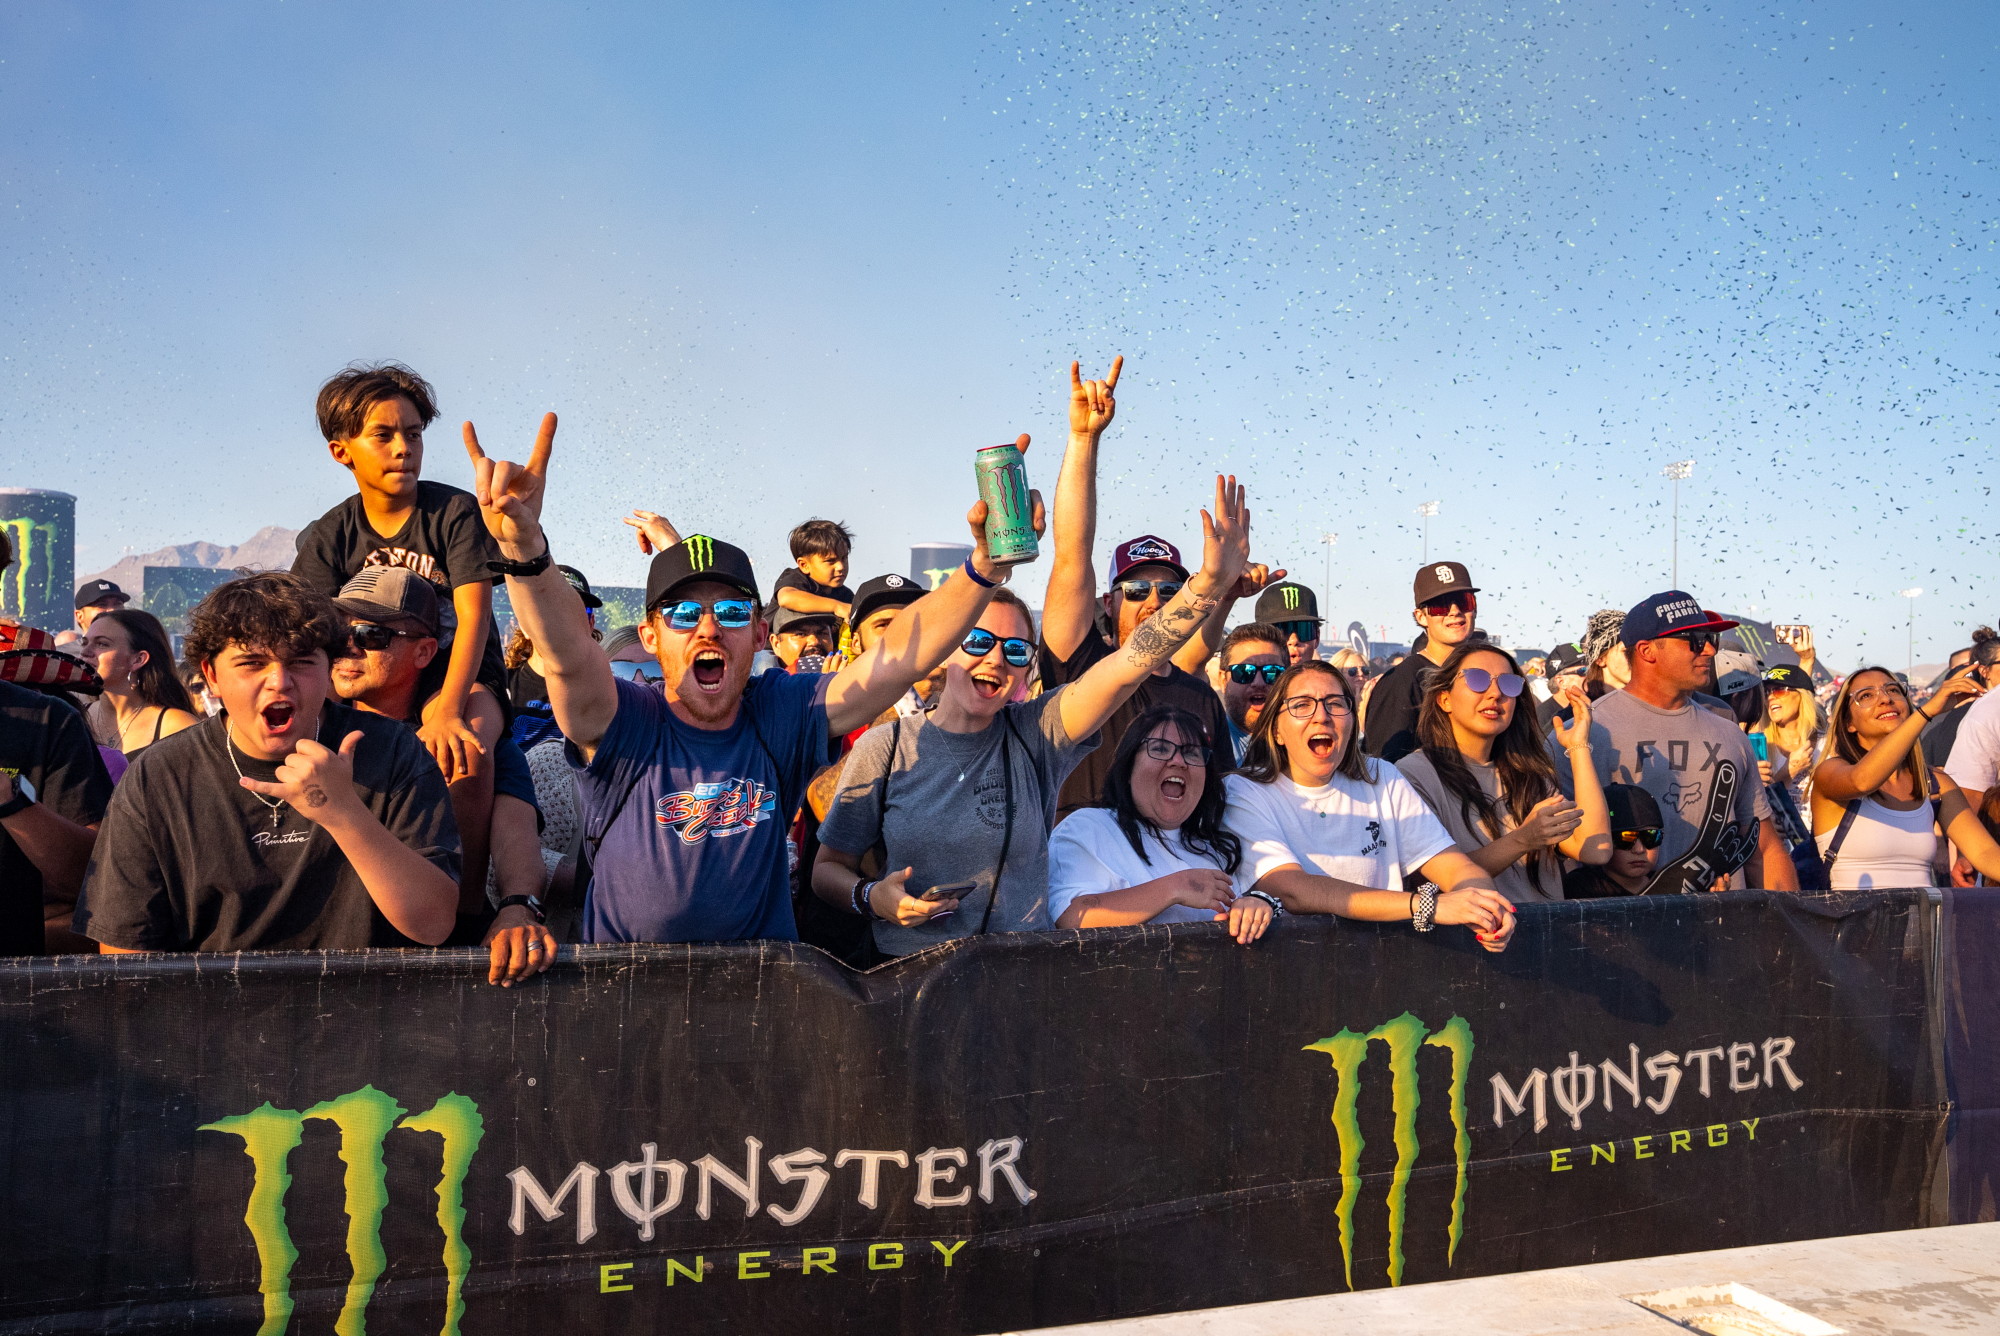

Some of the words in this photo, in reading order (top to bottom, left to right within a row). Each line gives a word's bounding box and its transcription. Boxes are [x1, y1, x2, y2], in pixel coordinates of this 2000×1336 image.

[1135, 546, 1166, 556] Hooey
[1655, 599, 1697, 618] FREEFO
[1728, 681, 1744, 690] KTM
[1635, 740, 1722, 774] FOX
[975, 806, 1004, 830] MOTOCROSS
[251, 829, 311, 850] Primitive
[1489, 1036, 1804, 1133] MONSTER
[1550, 1118, 1760, 1172] ENERGY
[506, 1136, 1038, 1244] MONSTER
[600, 1240, 968, 1293] ENERGY
